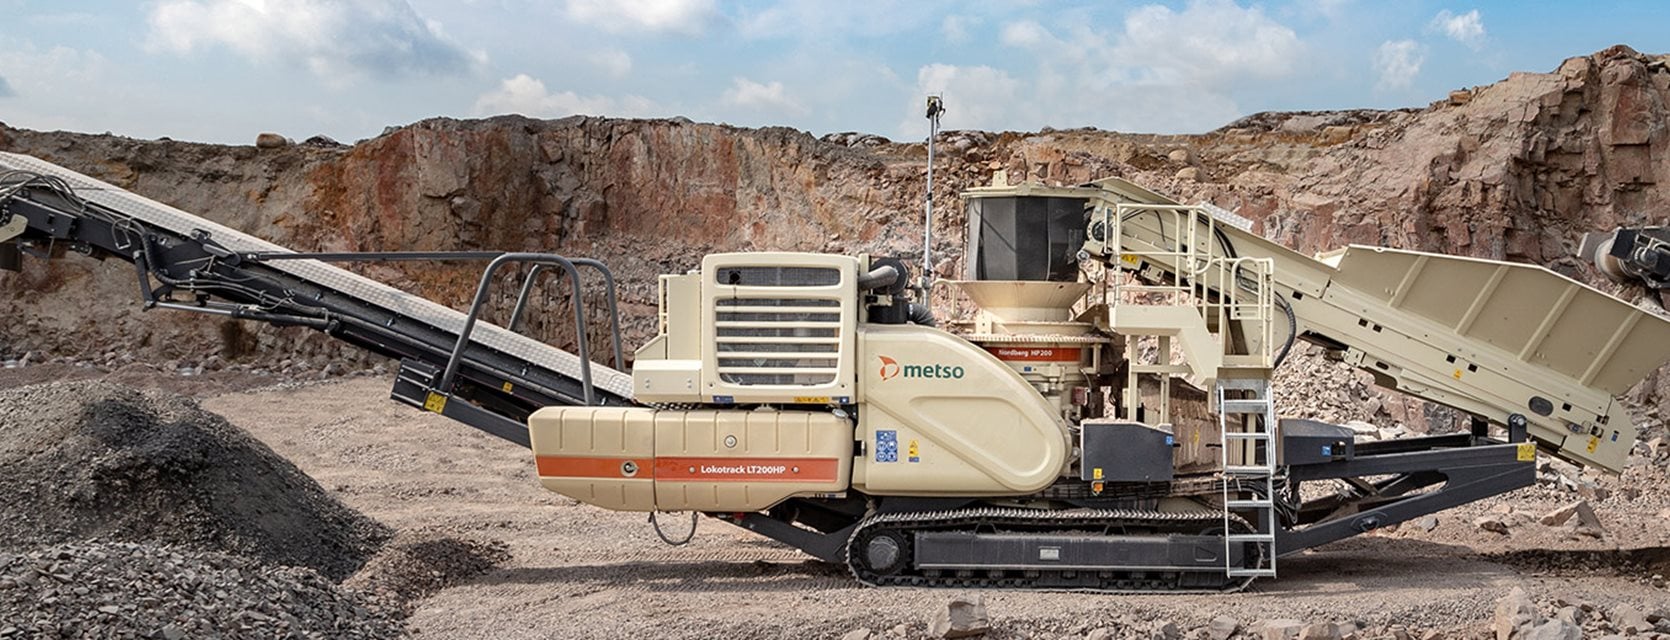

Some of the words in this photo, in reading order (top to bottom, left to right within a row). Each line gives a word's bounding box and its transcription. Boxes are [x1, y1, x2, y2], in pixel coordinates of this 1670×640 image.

[903, 364, 964, 379] metso
[701, 465, 745, 474] Lokotrack
[746, 465, 786, 474] LT200HP
